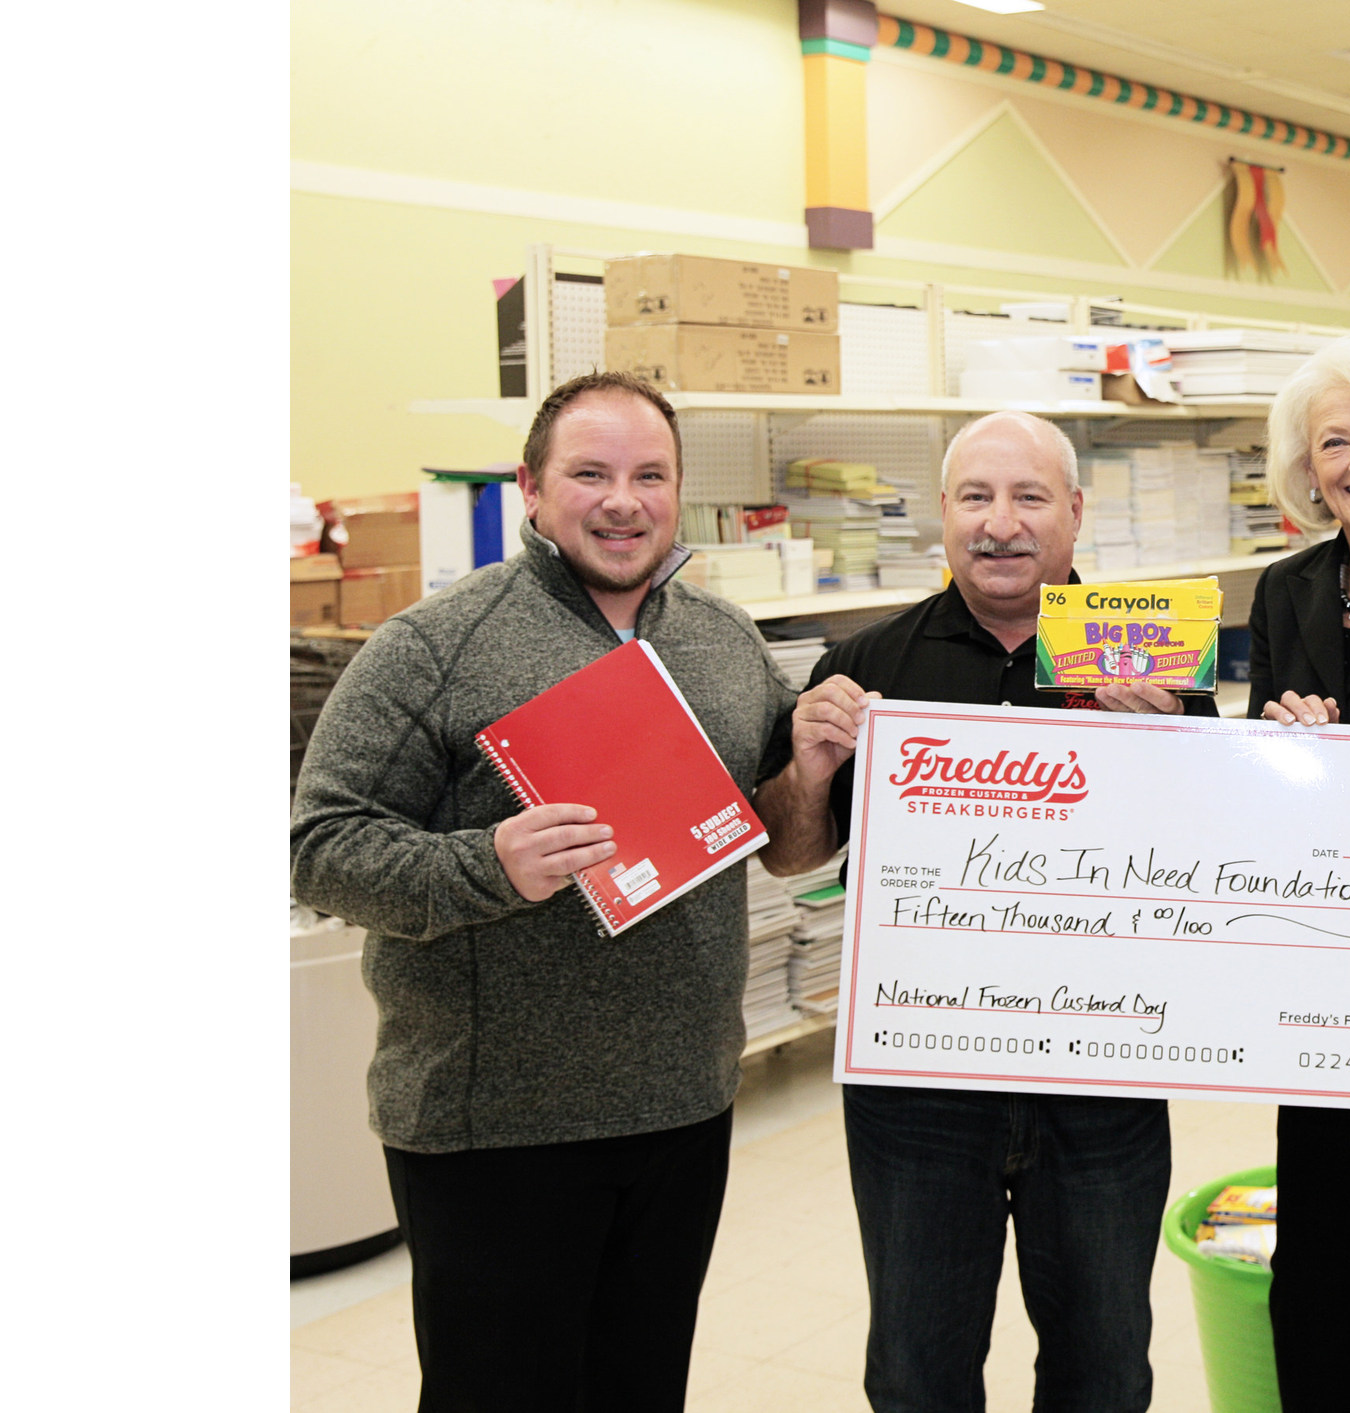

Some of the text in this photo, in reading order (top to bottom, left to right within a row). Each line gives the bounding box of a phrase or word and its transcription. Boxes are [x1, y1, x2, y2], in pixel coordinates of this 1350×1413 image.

[1046, 592, 1066, 605] 96
[1086, 592, 1171, 613] Crayola
[1085, 622, 1172, 646] BIG BOX
[1058, 651, 1194, 668] LIMITED EDITION
[889, 736, 1087, 792] Freddy's
[922, 787, 965, 797] FROZEN
[969, 790, 1014, 799] CUSTARD
[690, 801, 741, 839] 5 SUBJECT
[711, 824, 748, 851] WIDE RULED
[960, 833, 1047, 888] Kids
[1056, 848, 1110, 891] In
[1123, 847, 1201, 893] Need
[1312, 849, 1339, 859] DATE
[881, 865, 941, 877] PAY TO THE
[880, 879, 935, 889] ORDER OF
[893, 895, 987, 932] Fifteen
[991, 902, 1116, 937] Thousand
[874, 980, 1168, 1035] National Frozen Custard Day
[1279, 1011, 1340, 1027] Freddy's
